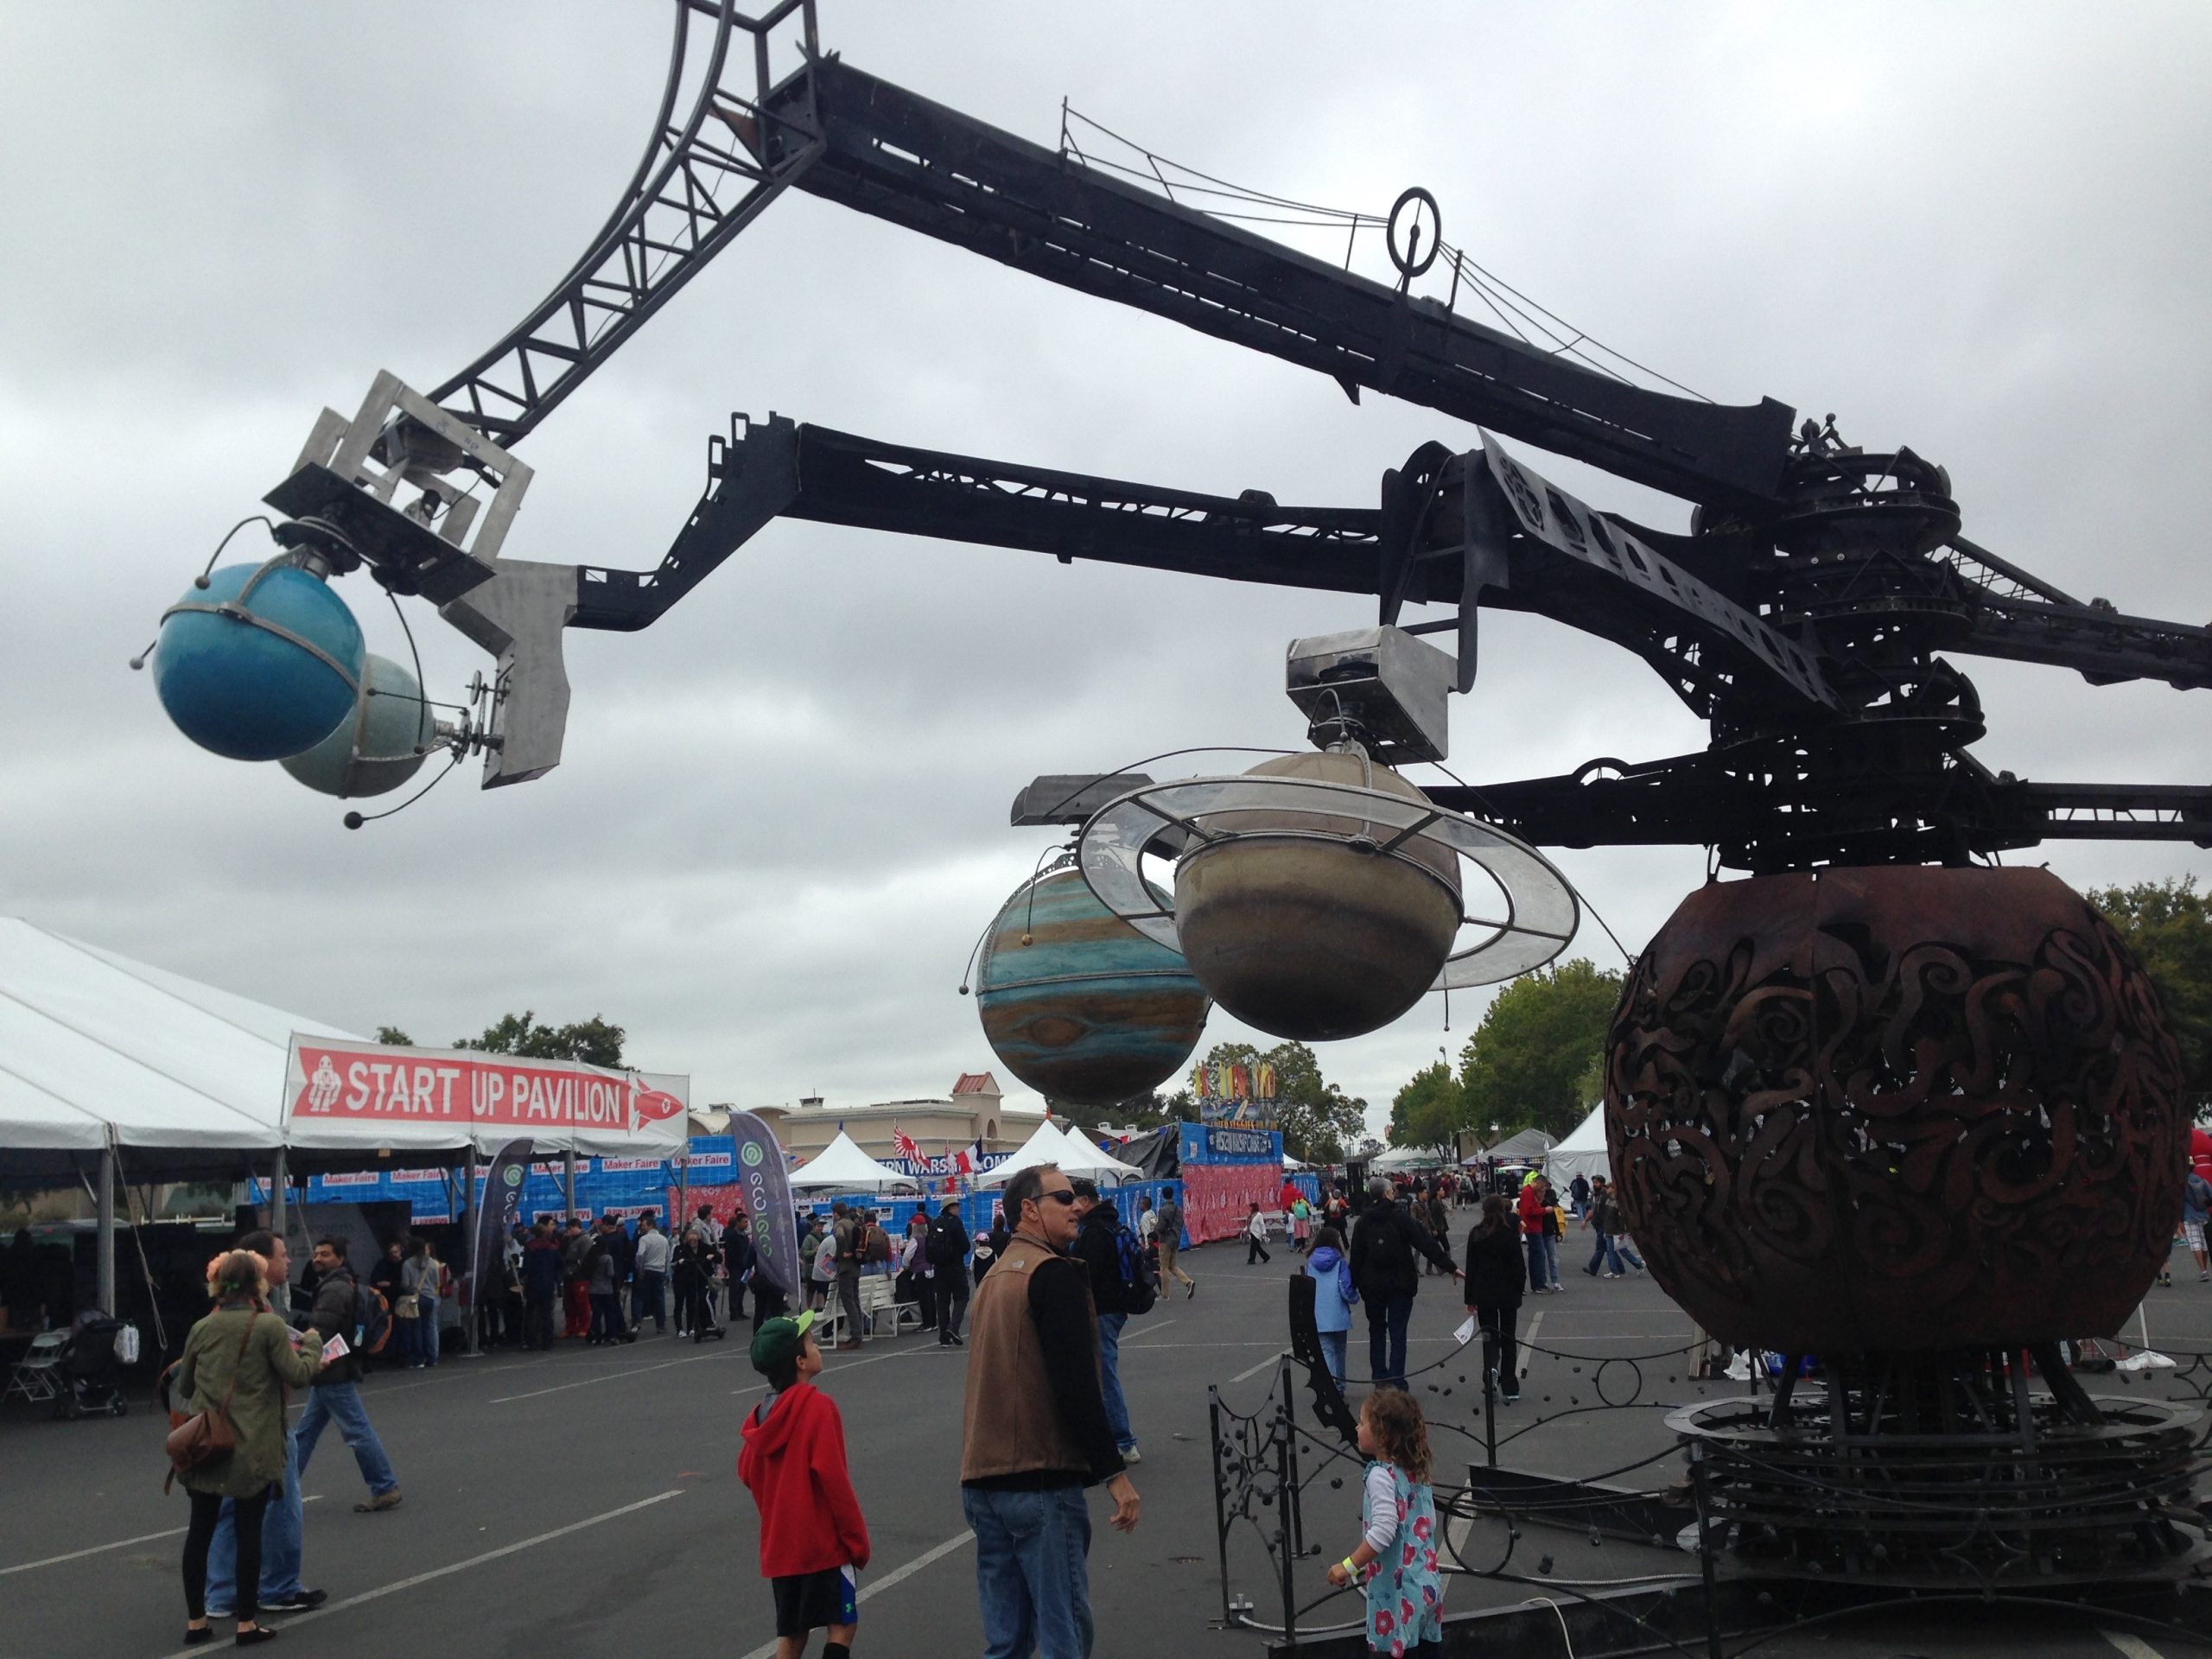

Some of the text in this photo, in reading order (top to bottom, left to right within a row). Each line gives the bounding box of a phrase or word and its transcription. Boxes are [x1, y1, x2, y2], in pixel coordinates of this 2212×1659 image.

[346, 1061, 620, 1123] START UP PAVILION
[604, 1159, 658, 1170] Maker Faire
[675, 1154, 729, 1166] Mker Faire
